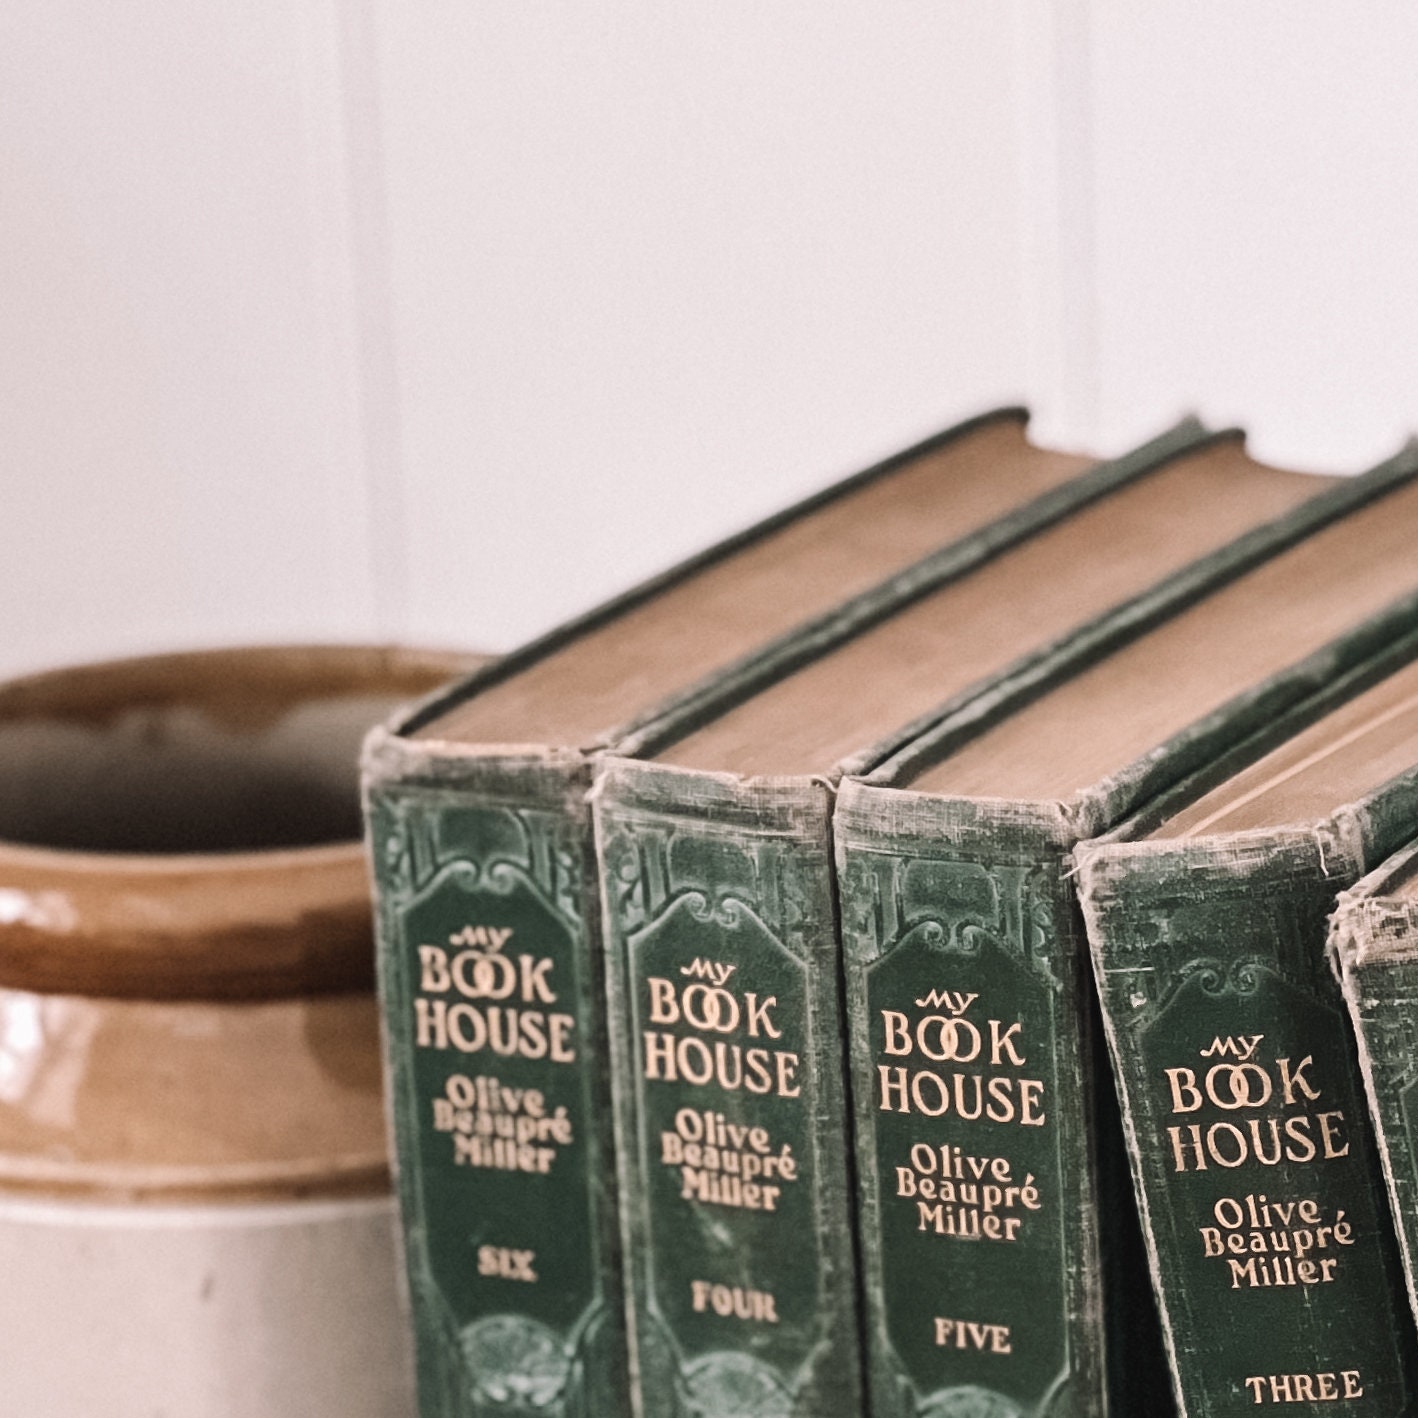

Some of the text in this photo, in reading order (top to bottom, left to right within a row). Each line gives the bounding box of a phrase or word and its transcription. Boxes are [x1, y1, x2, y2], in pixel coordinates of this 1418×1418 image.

[418, 945, 556, 1003] BOOK
[648, 977, 782, 1039] BOOK
[414, 999, 576, 1063] HOUSE
[880, 1010, 1026, 1066] BOOK
[643, 1032, 800, 1097] HOUSE
[1164, 1055, 1321, 1113] BOOK
[445, 1074, 545, 1116] Olive
[877, 1065, 1045, 1126] HOUSE
[433, 1097, 573, 1144] Beaupré
[674, 1108, 770, 1153] Olive
[1167, 1111, 1349, 1173] HOUSE
[454, 1133, 556, 1174] Miller
[661, 1131, 797, 1180] Beaupré
[910, 1143, 1012, 1181] Olive
[680, 1167, 780, 1210] Miller
[896, 1166, 1041, 1212] Beaupré
[917, 1202, 1021, 1241] Miller
[1200, 1210, 1355, 1258] Beaupré
[1213, 1195, 1321, 1230] Olive
[477, 1245, 538, 1282] SIX
[1227, 1256, 1337, 1289] Miller
[690, 1281, 779, 1323] FOUR
[934, 1317, 1012, 1354] FIVE
[1245, 1370, 1363, 1404] THREE
